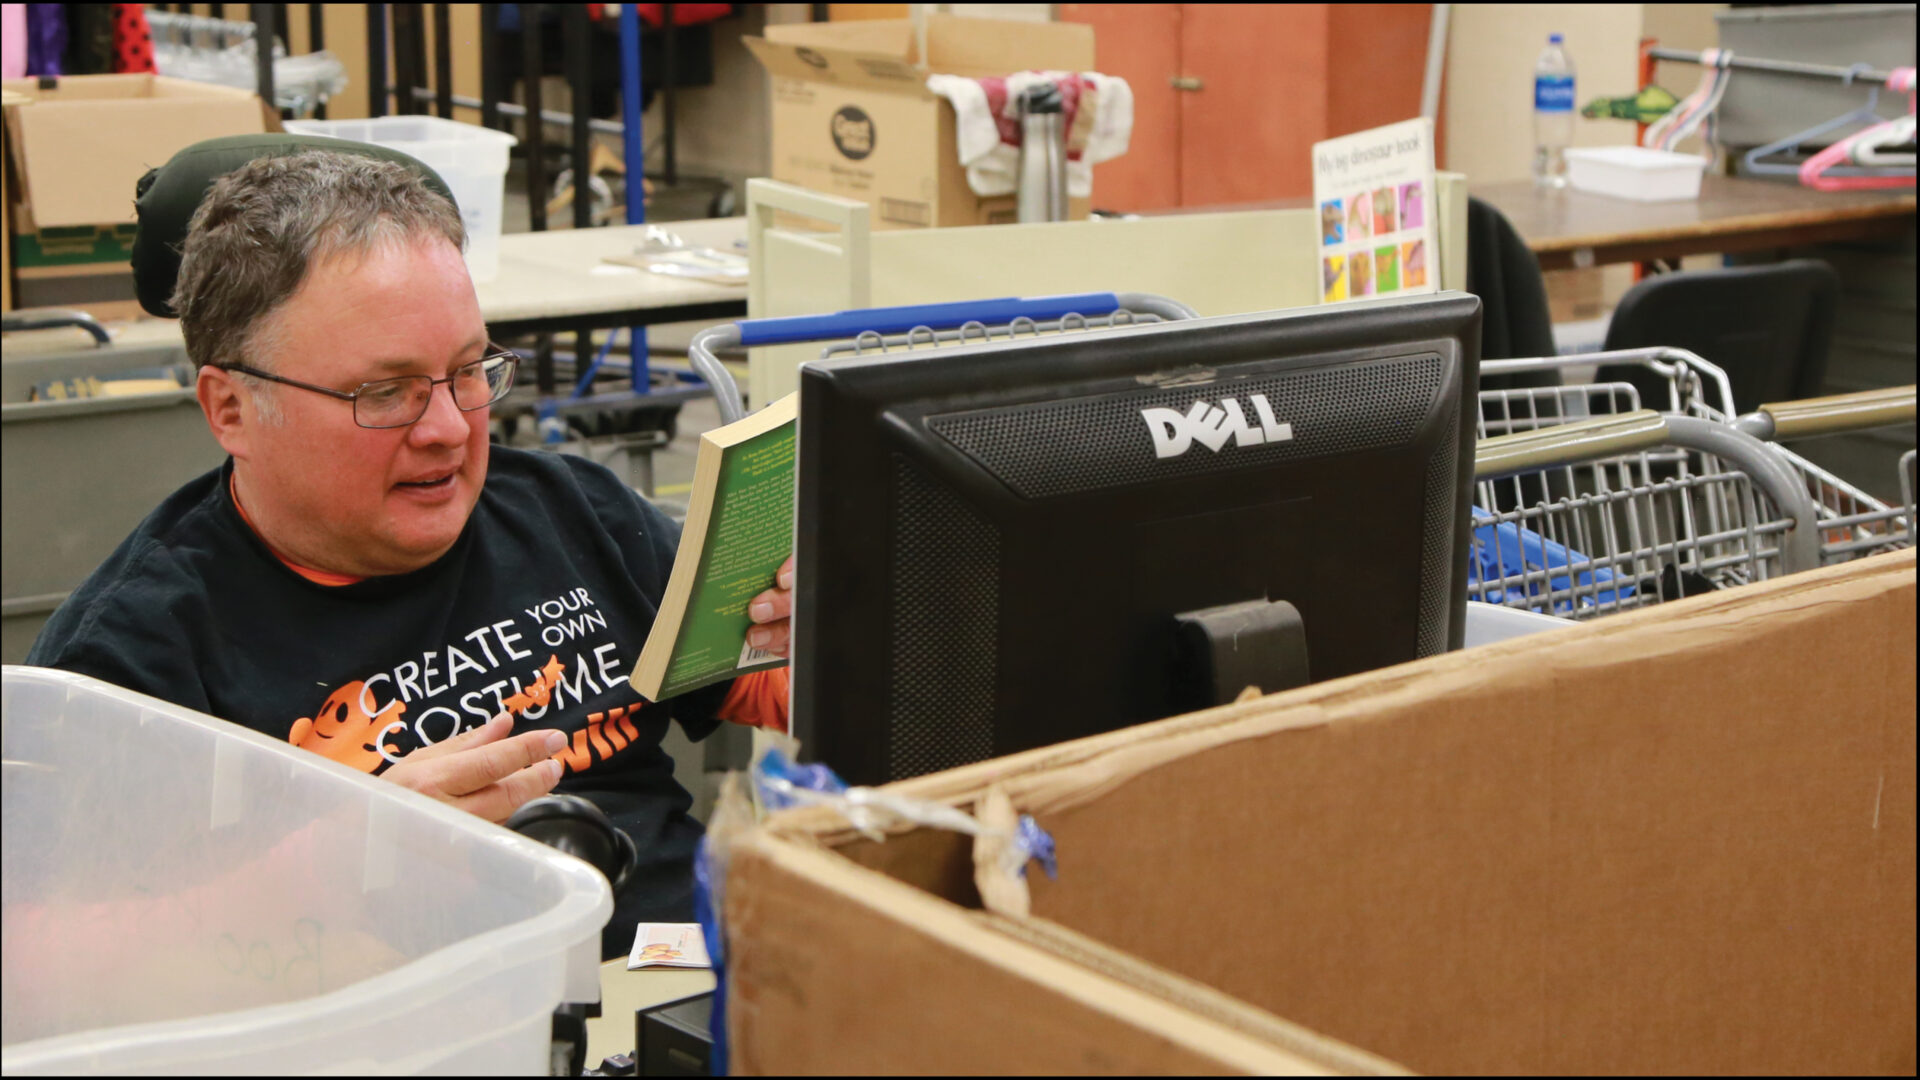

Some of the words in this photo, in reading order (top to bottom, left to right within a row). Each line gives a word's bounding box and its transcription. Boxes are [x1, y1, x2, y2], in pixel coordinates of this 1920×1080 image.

[1395, 130, 1420, 155] book
[1141, 394, 1293, 459] DELL
[525, 587, 594, 625] YOUR
[541, 609, 607, 646] OWN
[359, 619, 533, 719] CREATE
[376, 642, 630, 764] COSTUME
